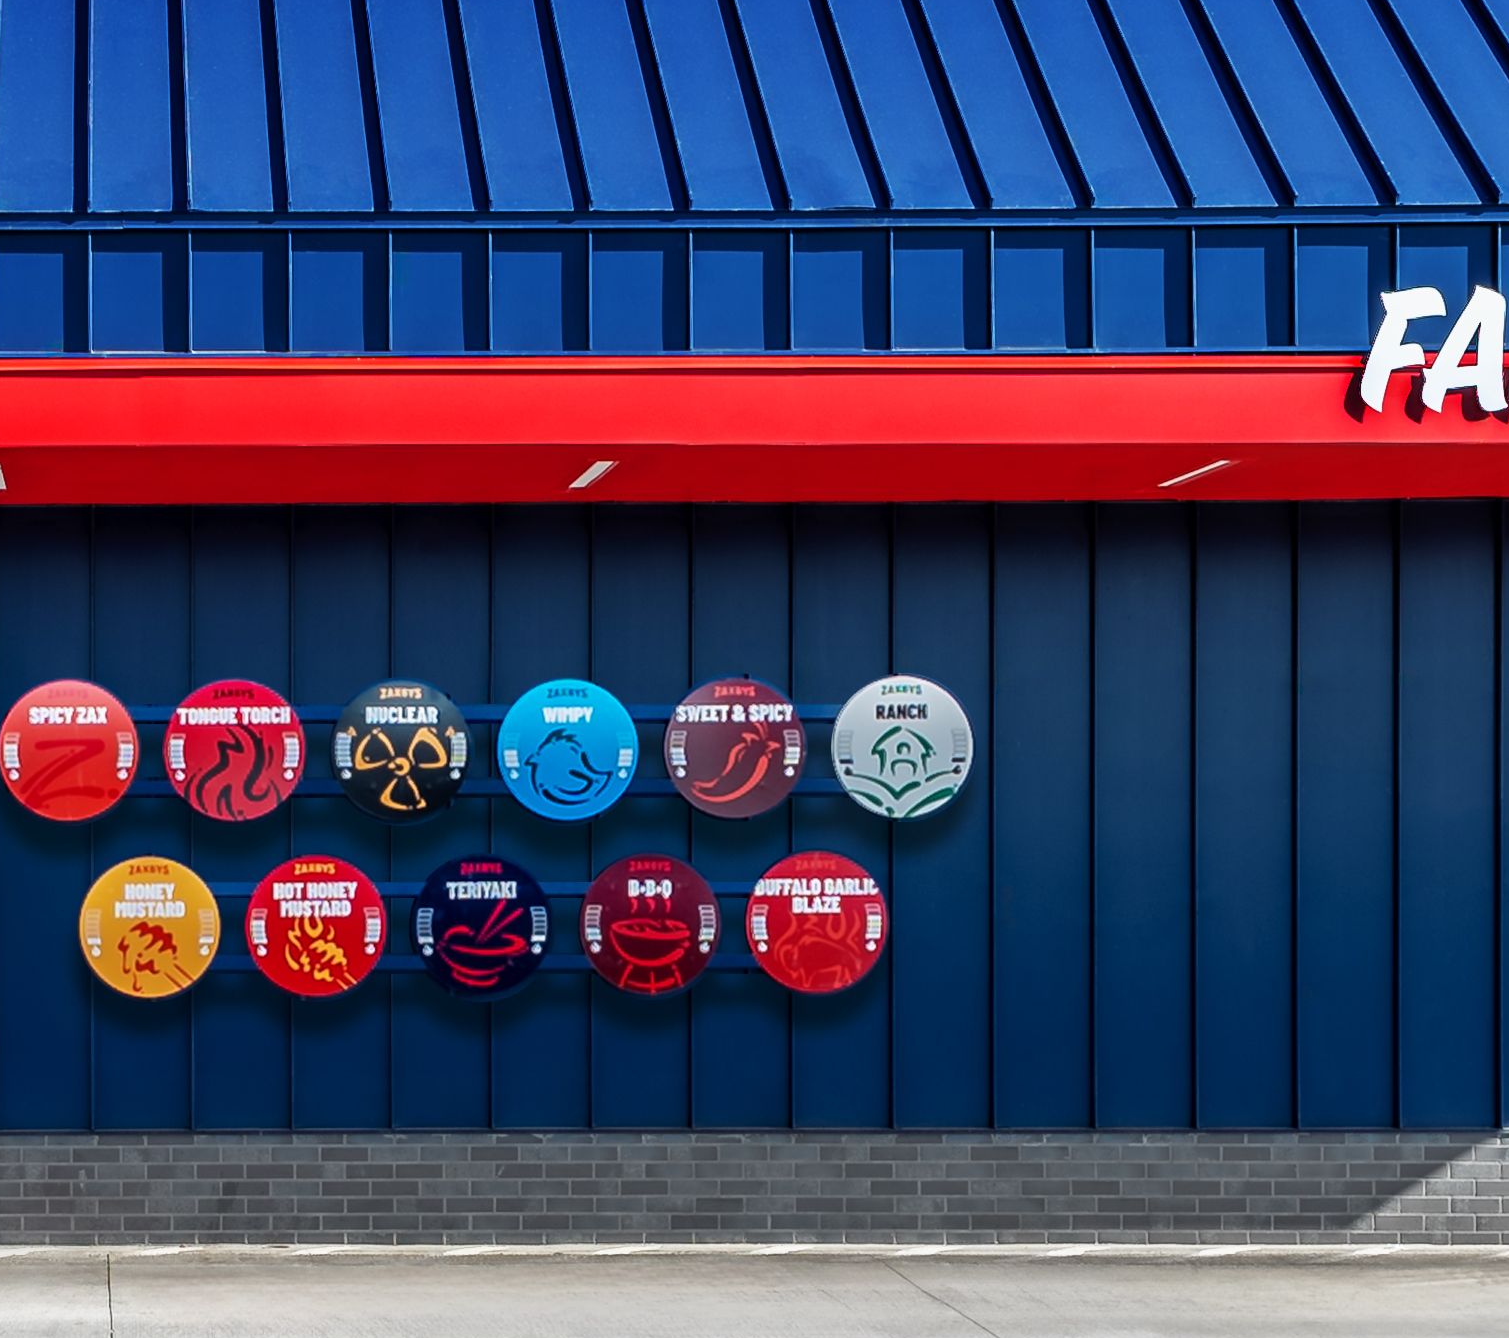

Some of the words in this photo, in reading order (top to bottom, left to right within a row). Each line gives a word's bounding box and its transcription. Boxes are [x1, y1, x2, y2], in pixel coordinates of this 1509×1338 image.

[28, 706, 74, 724] SPICY
[75, 706, 108, 724] ZAX
[176, 707, 238, 725] TONGUE
[239, 706, 291, 724] TORCH
[365, 706, 439, 724] NUCLEAR
[542, 706, 594, 723] WIMPY
[675, 704, 730, 722] SWEET
[731, 703, 746, 722] &
[747, 703, 793, 722] SPICY
[875, 703, 928, 720] RANCH
[124, 883, 175, 900] HONEY
[273, 882, 304, 900] HOT
[306, 881, 358, 900] HONEY
[446, 881, 518, 900] TERIYAKI
[754, 877, 823, 897] BUFFALO
[824, 877, 879, 897] GARLIC
[114, 900, 186, 918] MUSTARD
[280, 899, 352, 918] MUSTARD
[791, 896, 841, 914] BLAZE
